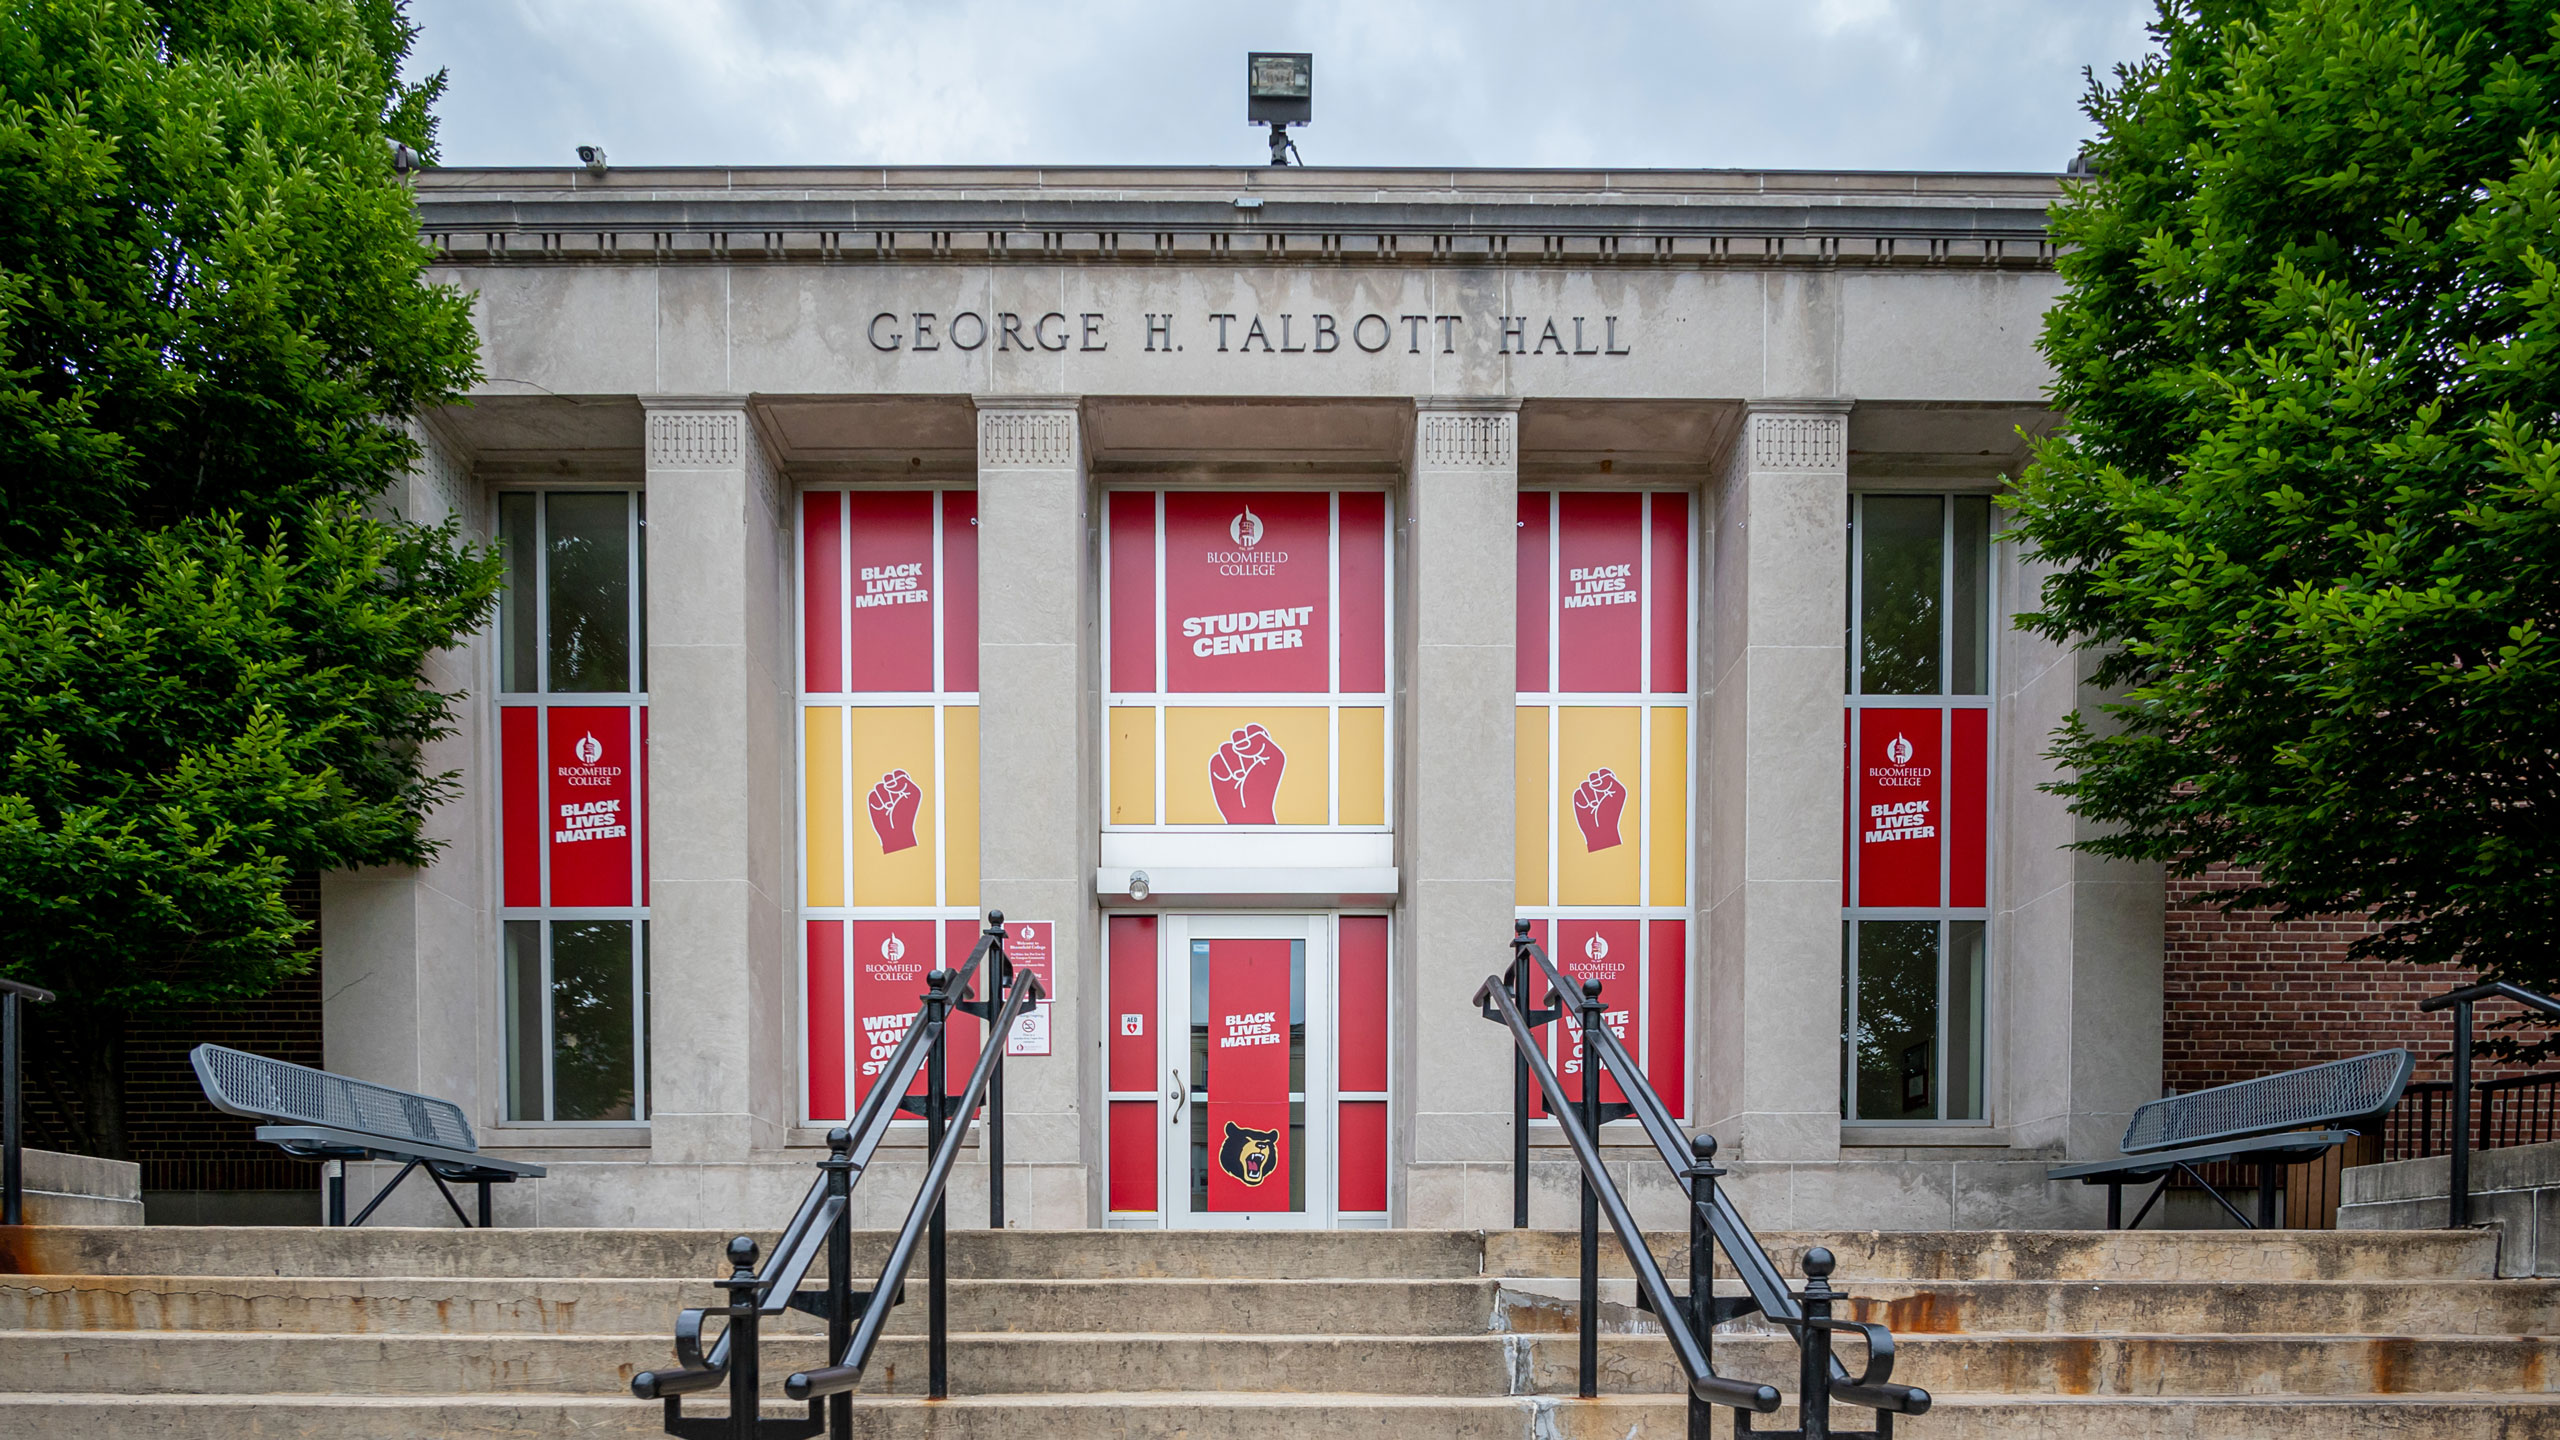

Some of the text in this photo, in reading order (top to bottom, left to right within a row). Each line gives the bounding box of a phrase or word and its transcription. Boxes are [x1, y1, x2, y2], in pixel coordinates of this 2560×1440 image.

[867, 312, 1631, 355] GEORGE H. TALBOTT HALL
[1207, 551, 1289, 564] BLOOMFIELD
[861, 563, 922, 580] BLACK
[1219, 564, 1276, 576] COLLEGE
[1570, 564, 1631, 581] BLACK
[866, 577, 917, 593] LIVES
[1575, 578, 1626, 594] LIVES
[855, 589, 928, 608] MATTER
[1564, 590, 1637, 609] MATTER
[1182, 606, 1313, 637] STUDENT
[1193, 629, 1303, 657] CENTER
[558, 767, 621, 776] BLOOMFIELD
[1869, 767, 1931, 777] BLOOMFIELD
[568, 776, 612, 786] COLLEGE
[1879, 777, 1921, 786] COLLEGE
[561, 799, 621, 817] BLACK
[1871, 800, 1930, 817] BLACK
[566, 813, 616, 829] LIVES
[1876, 814, 1925, 829] LIVES
[555, 825, 627, 843] MATTER
[1865, 826, 1935, 843] MATTER
[865, 964, 922, 973] BLOOMFIELD
[1569, 963, 1625, 971] BLOOMFIELD
[874, 972, 913, 981] COLLEGE
[1578, 971, 1617, 980] COLLEGE
[862, 1012, 919, 1031] WRIT
[1225, 1012, 1275, 1026] BLACK
[866, 1028, 909, 1045] YOU
[1229, 1023, 1271, 1037] LIVES
[1569, 1026, 1625, 1043] YR
[1220, 1033, 1280, 1048] MATTER
